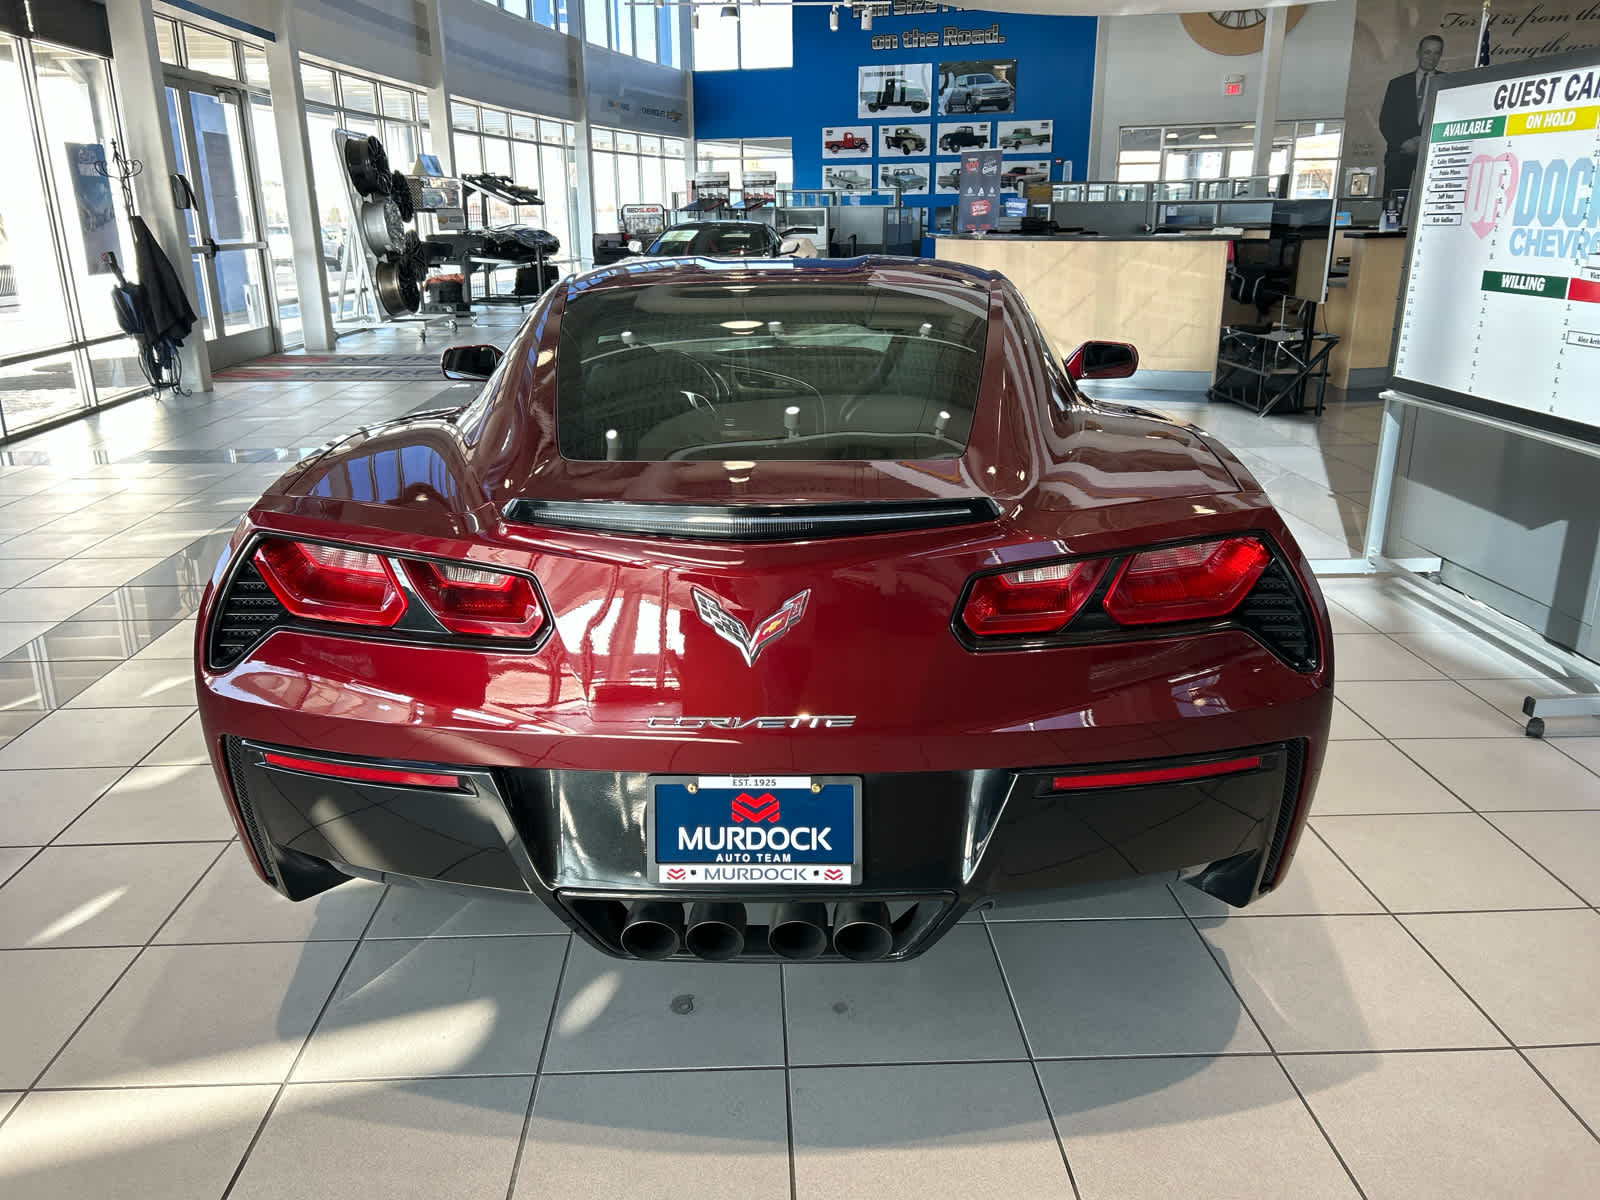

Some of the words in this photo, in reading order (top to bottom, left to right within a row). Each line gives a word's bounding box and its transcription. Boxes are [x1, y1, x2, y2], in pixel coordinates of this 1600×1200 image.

[1511, 3, 1569, 37] from
[871, 34, 898, 50] on
[902, 28, 939, 48] the
[942, 24, 1005, 46] Road.
[1490, 32, 1571, 58] trength
[1226, 84, 1240, 95] EXIT
[1493, 76, 1562, 110] GUEST
[1526, 114, 1542, 129] ON
[1543, 110, 1577, 128] HOLD
[1443, 120, 1494, 137] AVAILABLE
[1501, 274, 1546, 291] WILLING
[646, 715, 857, 730] CORVETTE
[732, 778, 752, 787] EST.
[753, 778, 777, 787] 1925
[678, 826, 833, 852] MURDOCK
[716, 853, 753, 863] AUTO
[756, 853, 791, 863] TEAM
[704, 868, 807, 881] MURDOCK
